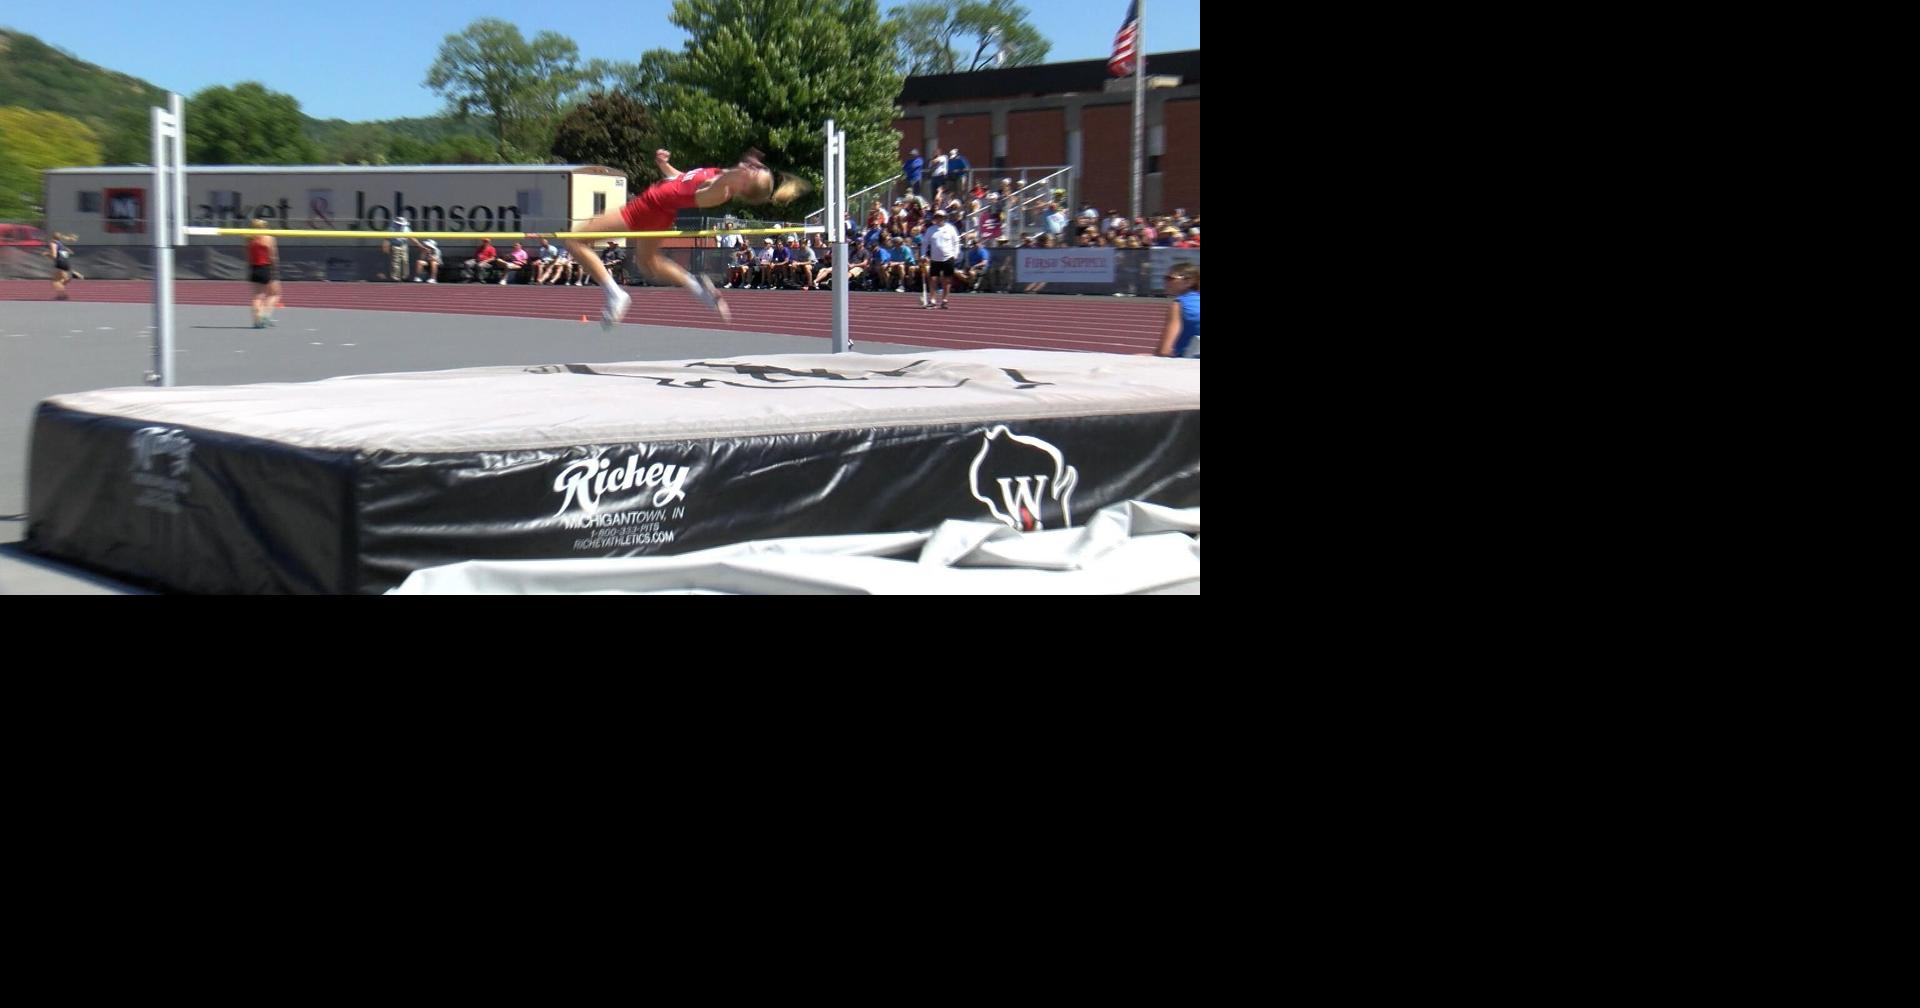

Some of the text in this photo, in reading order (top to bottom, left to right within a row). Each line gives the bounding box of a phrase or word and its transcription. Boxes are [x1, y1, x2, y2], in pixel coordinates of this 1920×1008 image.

[187, 191, 291, 229] arket
[347, 190, 522, 232] Johnson
[553, 454, 690, 518] Richey
[996, 475, 1049, 531] W
[672, 506, 685, 519] IN
[573, 530, 674, 550] RICHEYATHLETICS.COM
